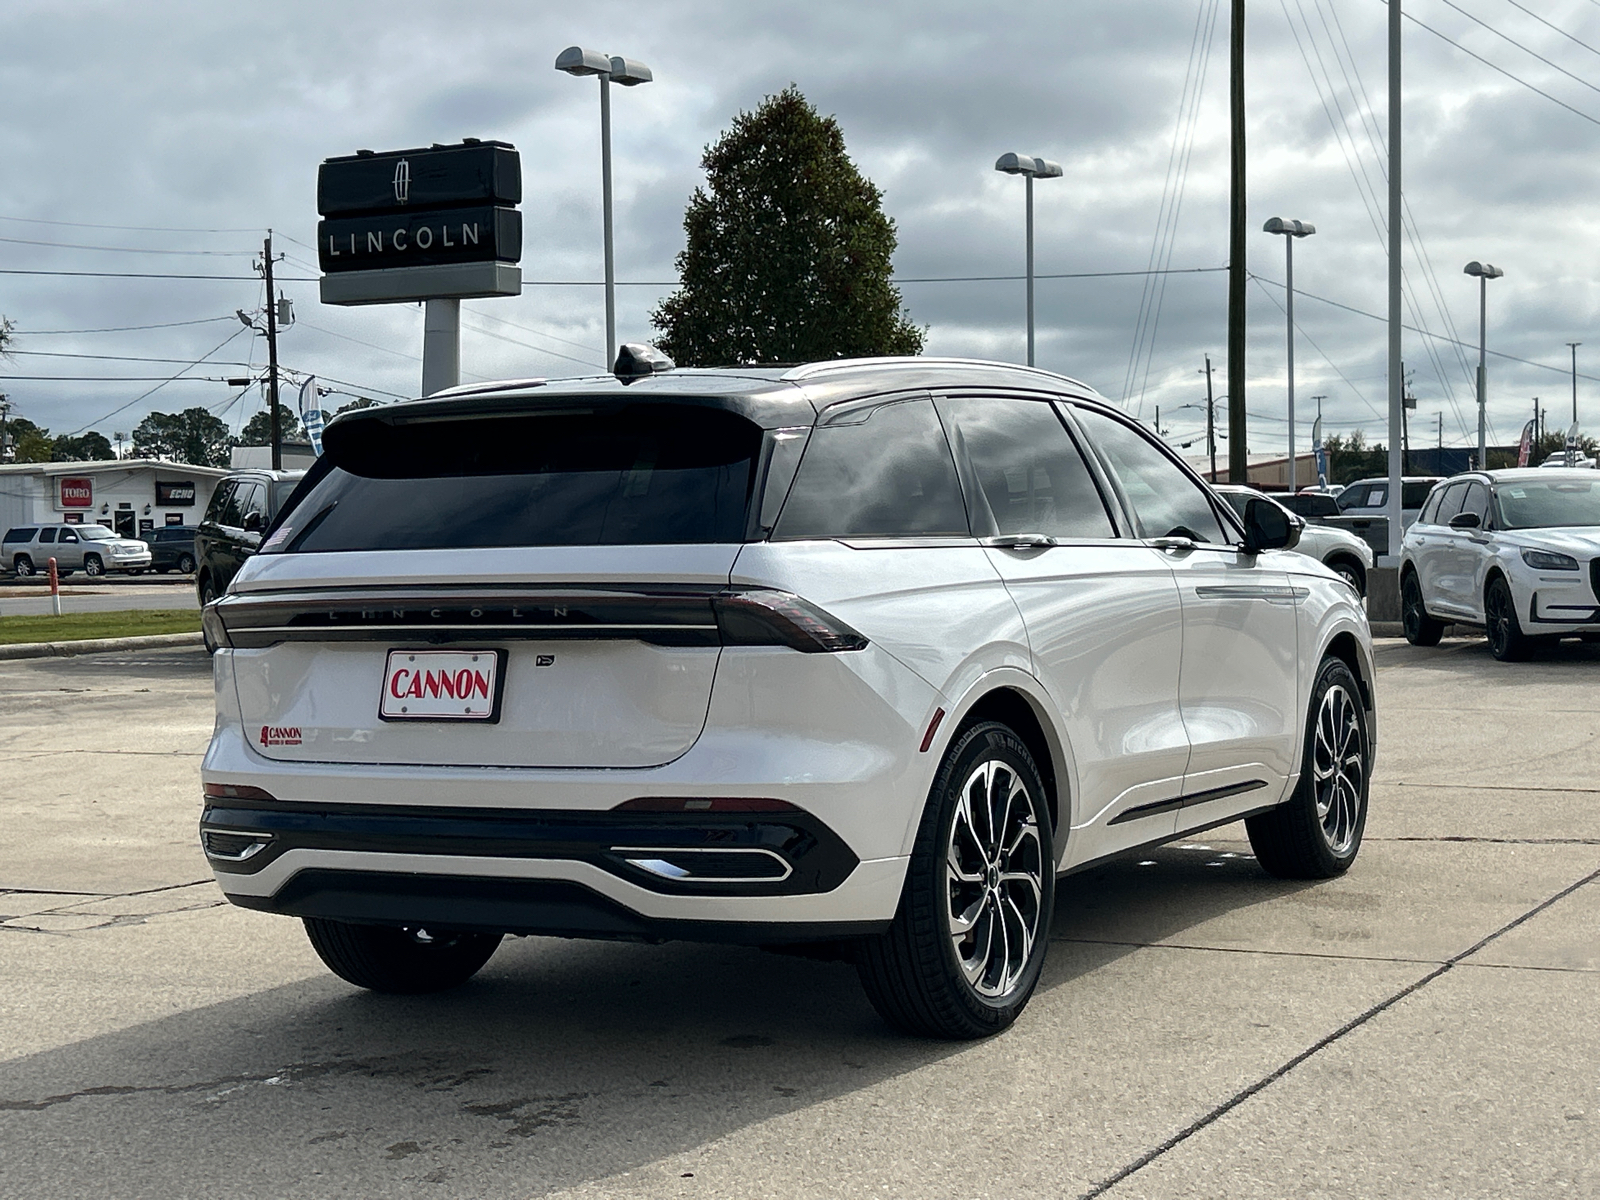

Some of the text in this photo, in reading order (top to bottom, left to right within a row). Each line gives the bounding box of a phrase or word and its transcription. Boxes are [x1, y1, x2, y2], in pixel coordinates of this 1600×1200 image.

[331, 223, 479, 256] LINCOLN
[64, 488, 90, 498] TORO
[169, 489, 194, 499] ECHO
[328, 606, 569, 620] LINCOLN
[390, 668, 491, 700] CANNON
[269, 727, 302, 738] CANNON
